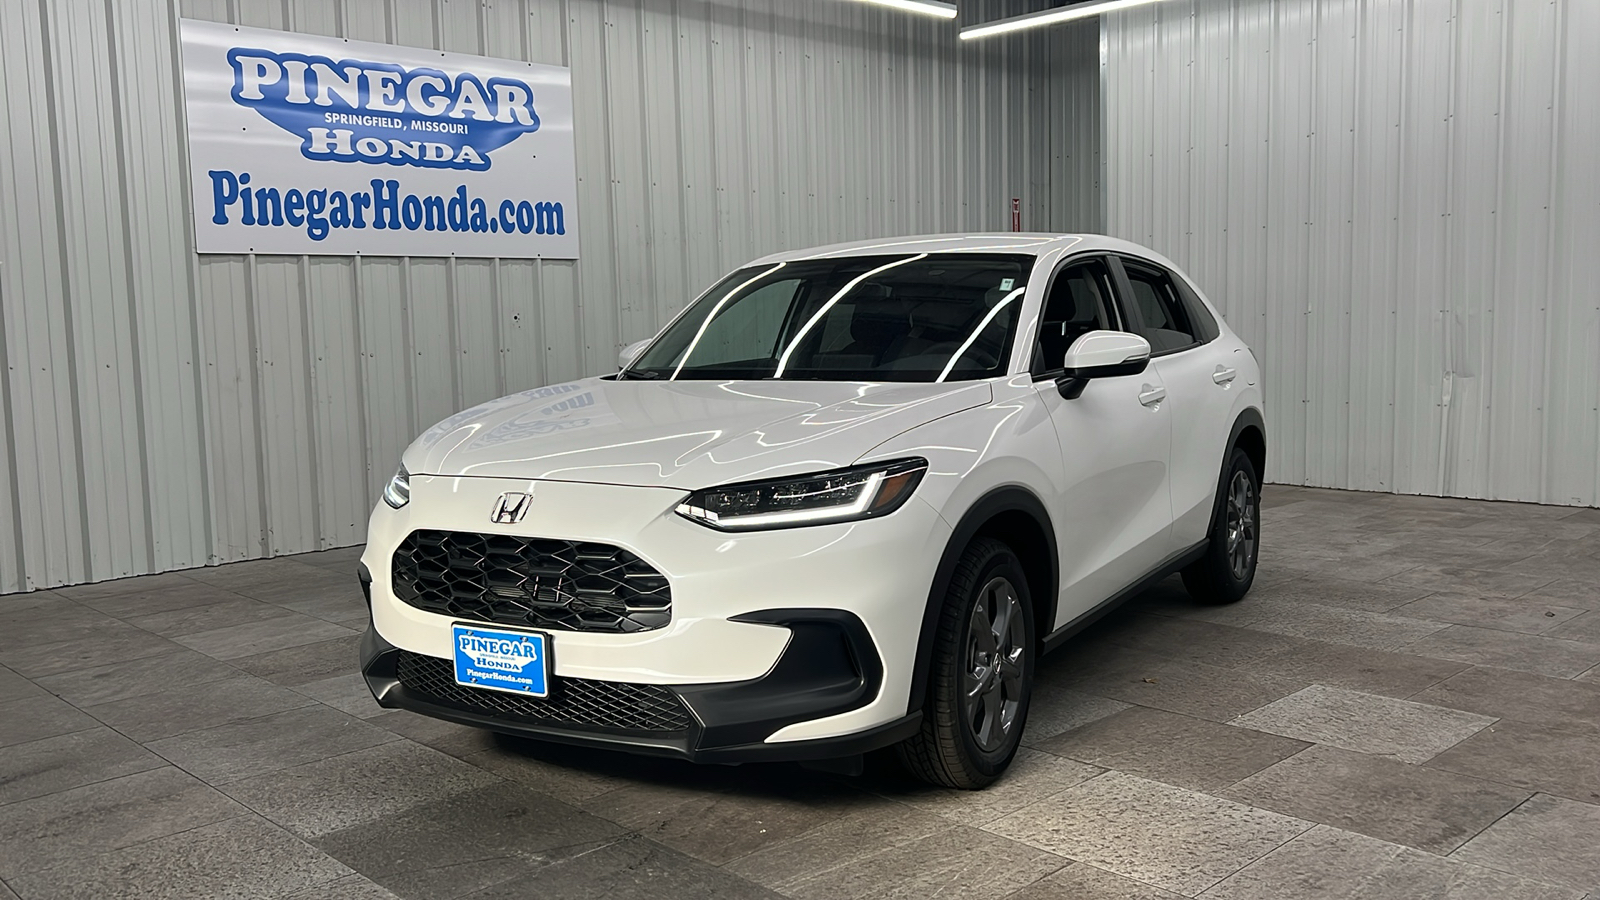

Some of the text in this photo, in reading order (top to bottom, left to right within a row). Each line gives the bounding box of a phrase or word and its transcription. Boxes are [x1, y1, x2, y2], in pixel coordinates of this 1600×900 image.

[235, 55, 534, 126] PINEGAR
[324, 112, 469, 135] SPRINGFIELD, MISSOURI
[307, 128, 485, 164] HONDA
[209, 170, 565, 241] PinegarHonda.com
[460, 637, 535, 658] PINEGAR
[476, 657, 520, 671] HONDA
[466, 668, 533, 685] PinegarHonda.com
